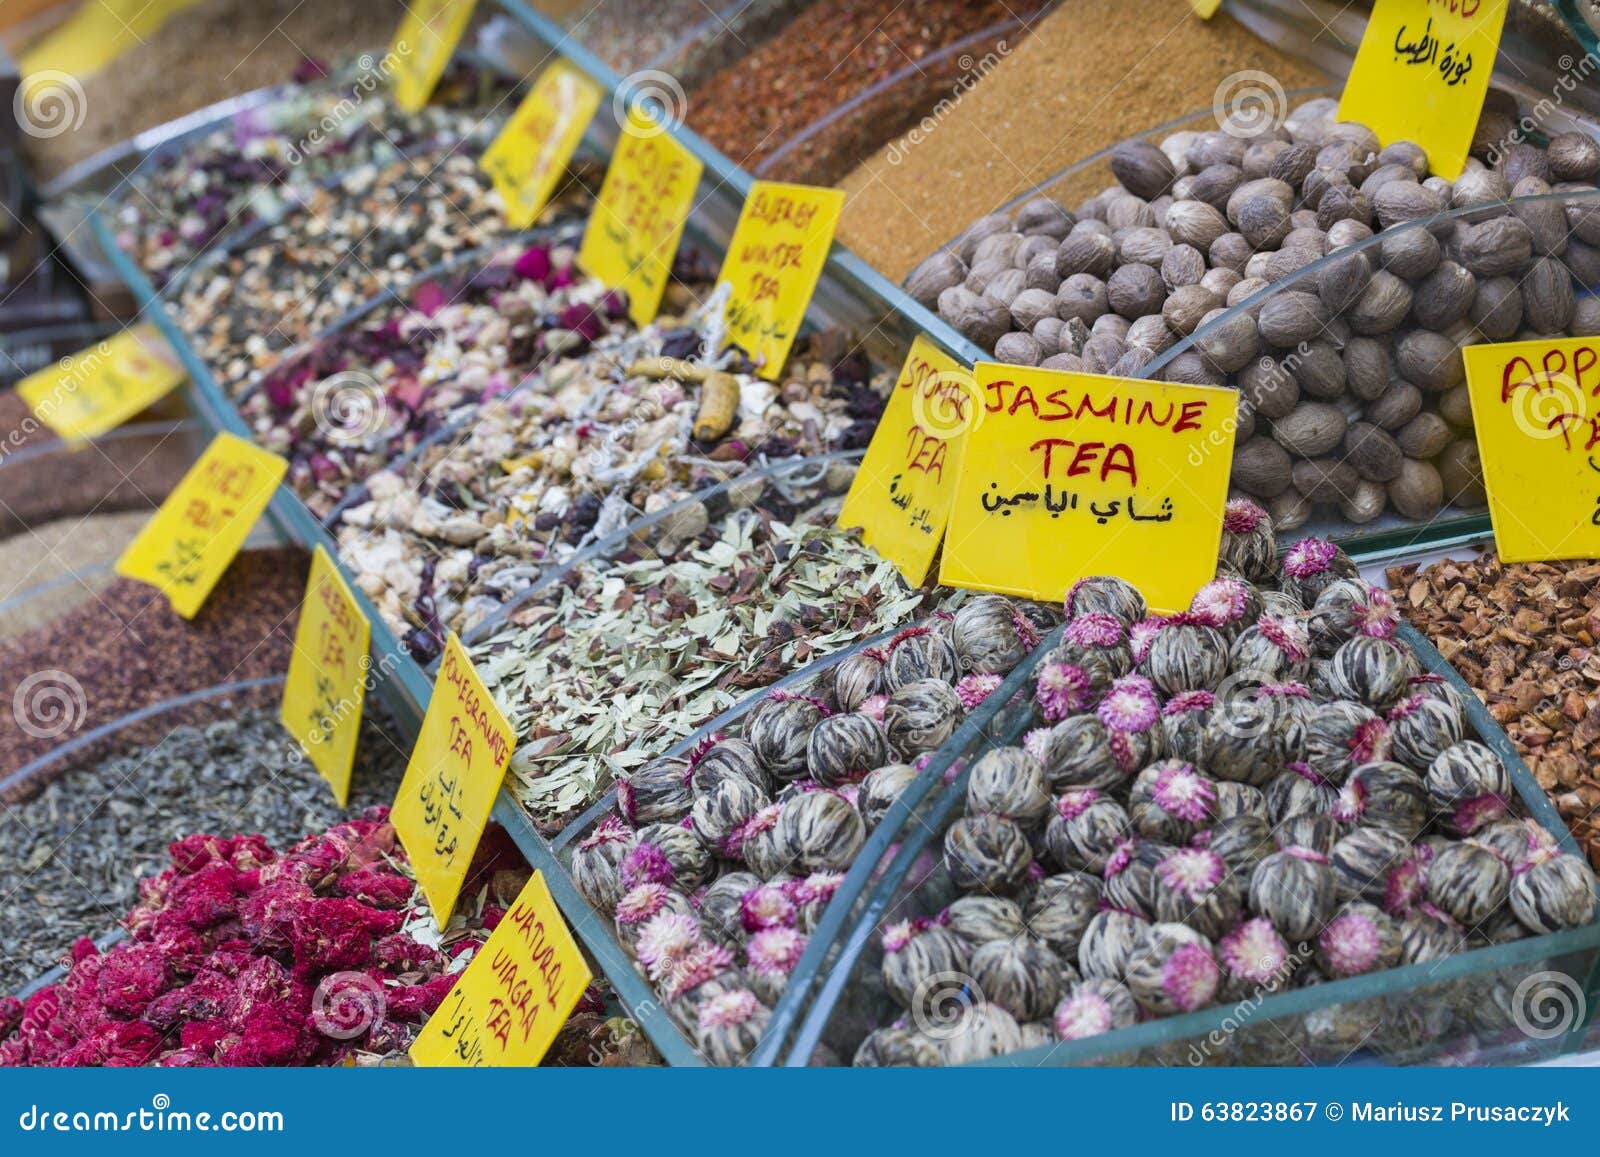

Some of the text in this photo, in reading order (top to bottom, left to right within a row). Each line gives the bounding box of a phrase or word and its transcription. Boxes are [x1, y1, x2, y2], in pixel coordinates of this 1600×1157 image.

[984, 380, 1208, 433] JASMINE
[907, 424, 948, 485] TEA
[1029, 438, 1138, 488] TEA
[450, 716, 473, 770] TEA
[510, 902, 565, 1012] NATURAL
[486, 998, 511, 1053] TEA
